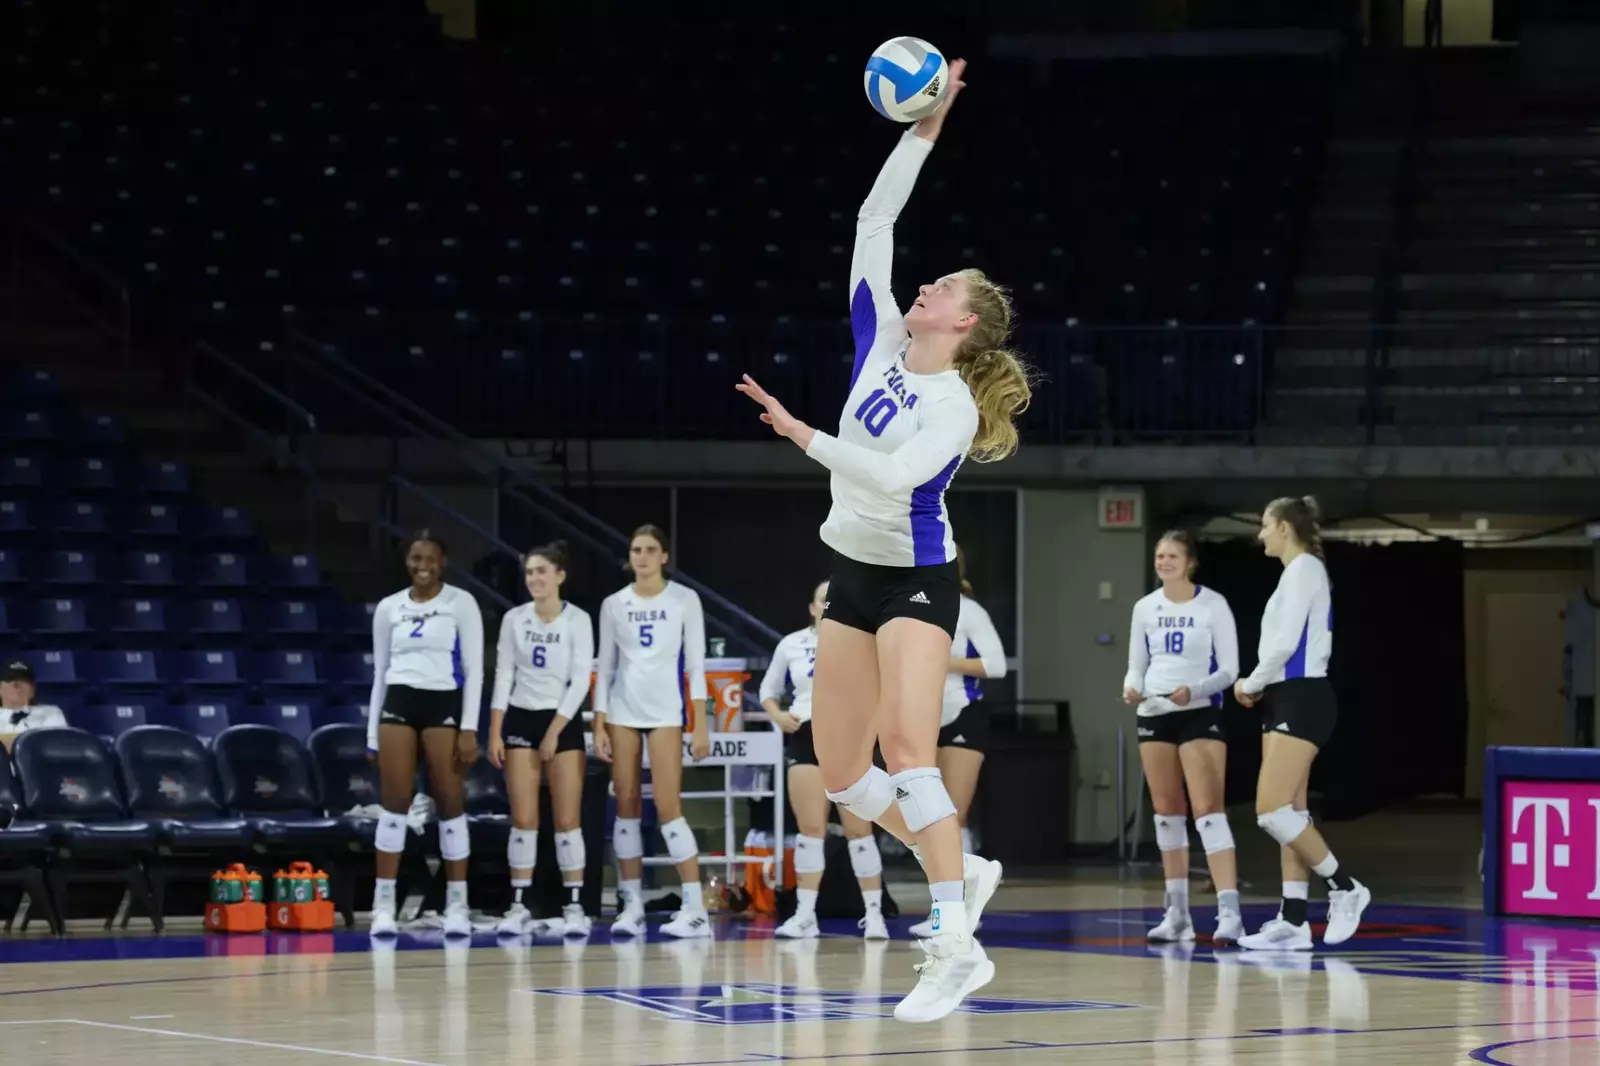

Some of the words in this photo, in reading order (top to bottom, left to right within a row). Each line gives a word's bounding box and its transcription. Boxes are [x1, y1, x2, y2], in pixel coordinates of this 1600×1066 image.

[854, 388, 898, 438] 10
[410, 617, 425, 638] 2
[627, 610, 668, 623] TULSA
[1157, 616, 1195, 629] TULSA
[524, 629, 561, 644] TULSA
[640, 624, 654, 648] 5
[1164, 631, 1185, 654] 18
[532, 646, 547, 669] 6
